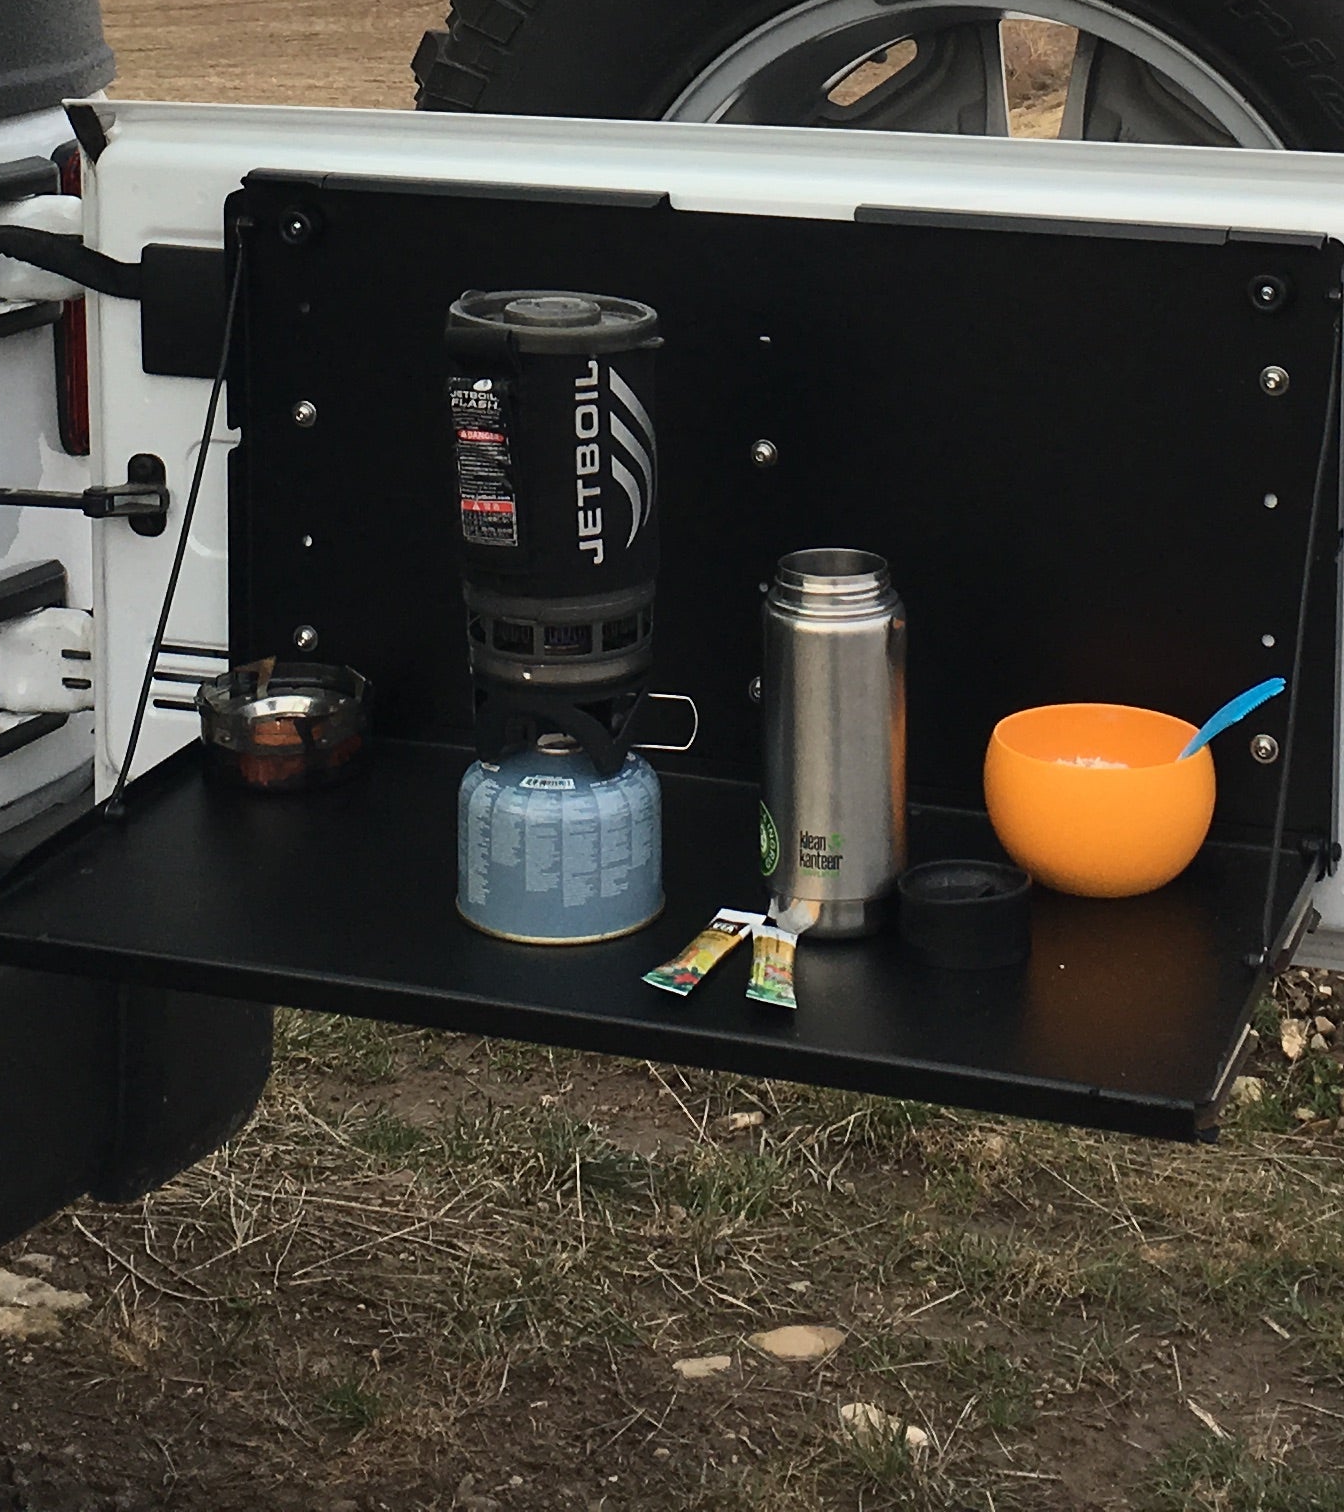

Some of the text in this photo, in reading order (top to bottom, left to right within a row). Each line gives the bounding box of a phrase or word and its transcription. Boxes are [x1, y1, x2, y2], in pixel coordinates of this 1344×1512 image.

[450, 390, 498, 401] JETBOIL
[451, 398, 499, 410] FLASH
[575, 360, 604, 565] JETBOIL
[799, 830, 826, 851] klean
[799, 849, 841, 870] kanteen
